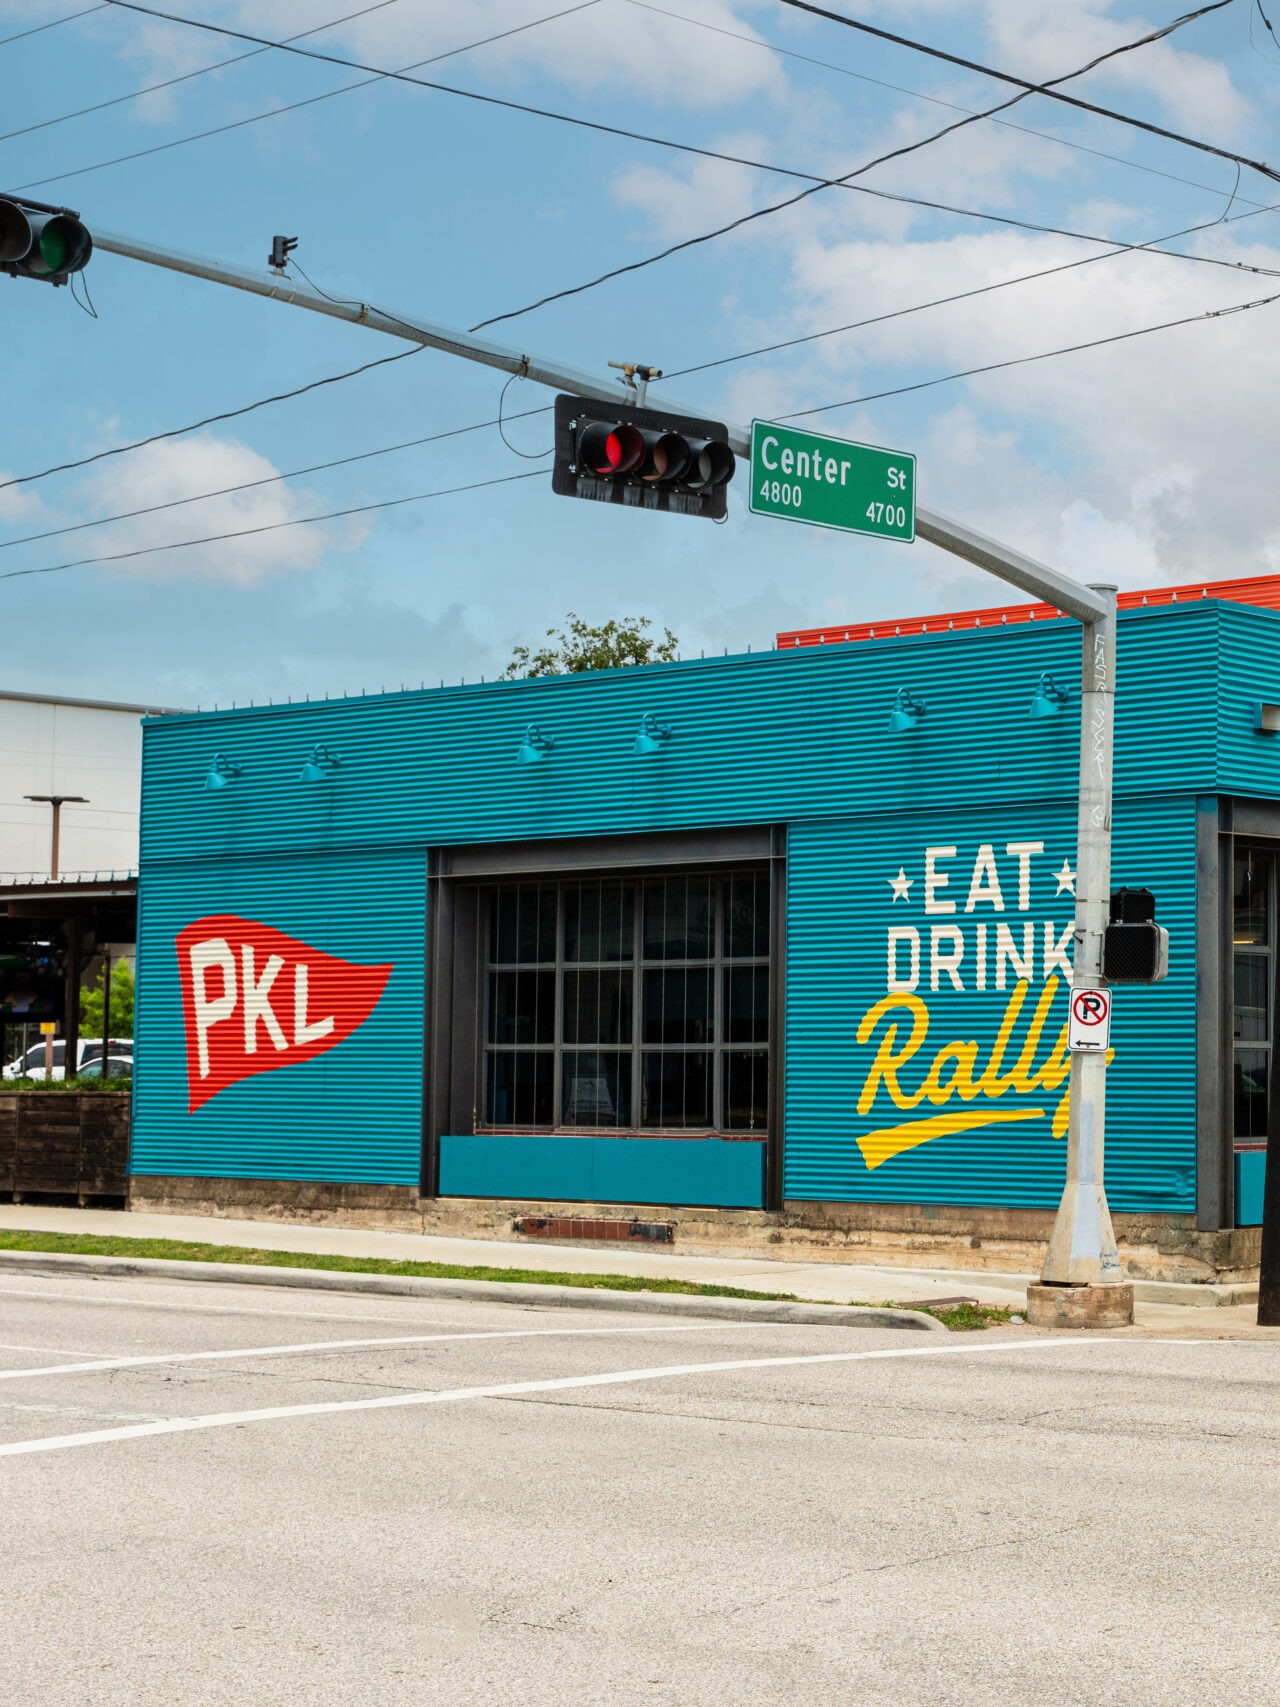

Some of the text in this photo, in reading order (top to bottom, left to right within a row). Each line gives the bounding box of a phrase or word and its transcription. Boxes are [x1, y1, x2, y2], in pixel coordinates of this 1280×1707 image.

[761, 436, 906, 490] Center St
[760, 480, 906, 527] 4800 4700
[925, 841, 1044, 915] EAT
[887, 921, 1076, 992] DRINK
[190, 938, 335, 1080] PKL
